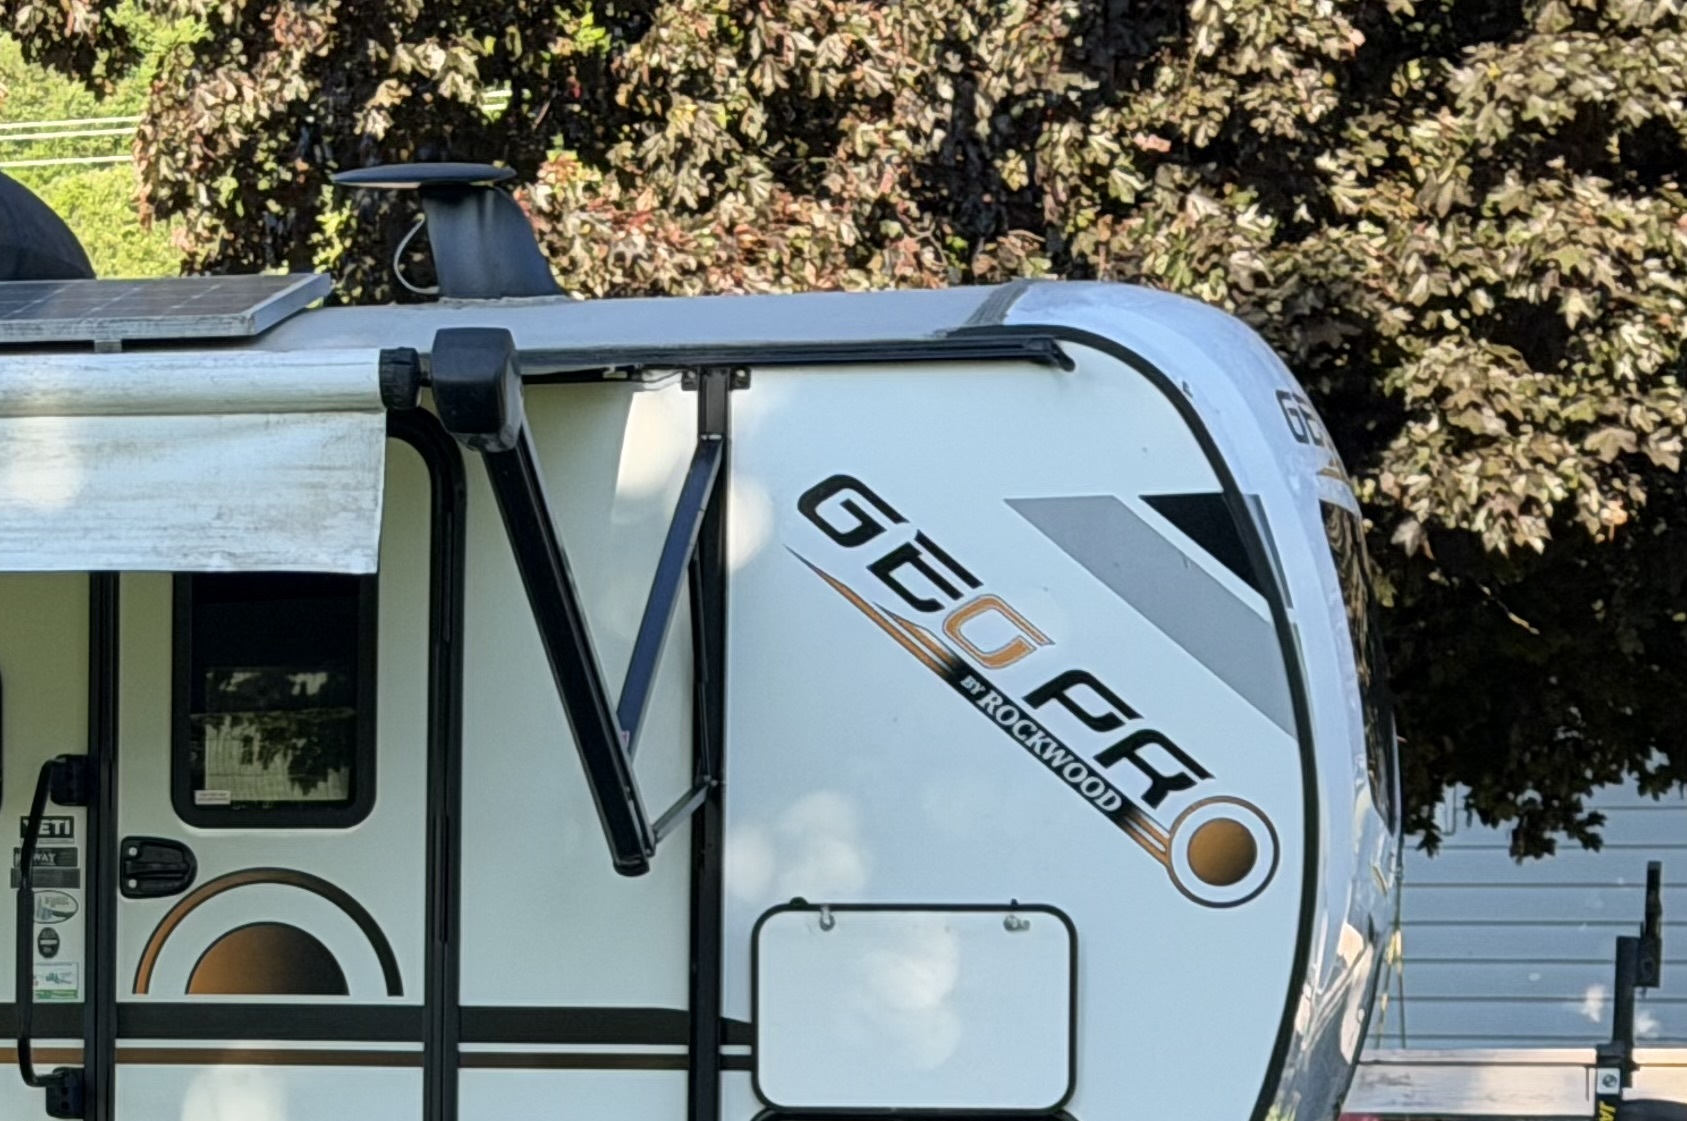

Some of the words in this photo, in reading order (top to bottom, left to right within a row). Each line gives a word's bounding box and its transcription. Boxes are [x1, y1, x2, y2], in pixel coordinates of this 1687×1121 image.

[796, 473, 1056, 671] GEO
[960, 674, 987, 696] BY
[975, 688, 1123, 813] ROCKWOOD
